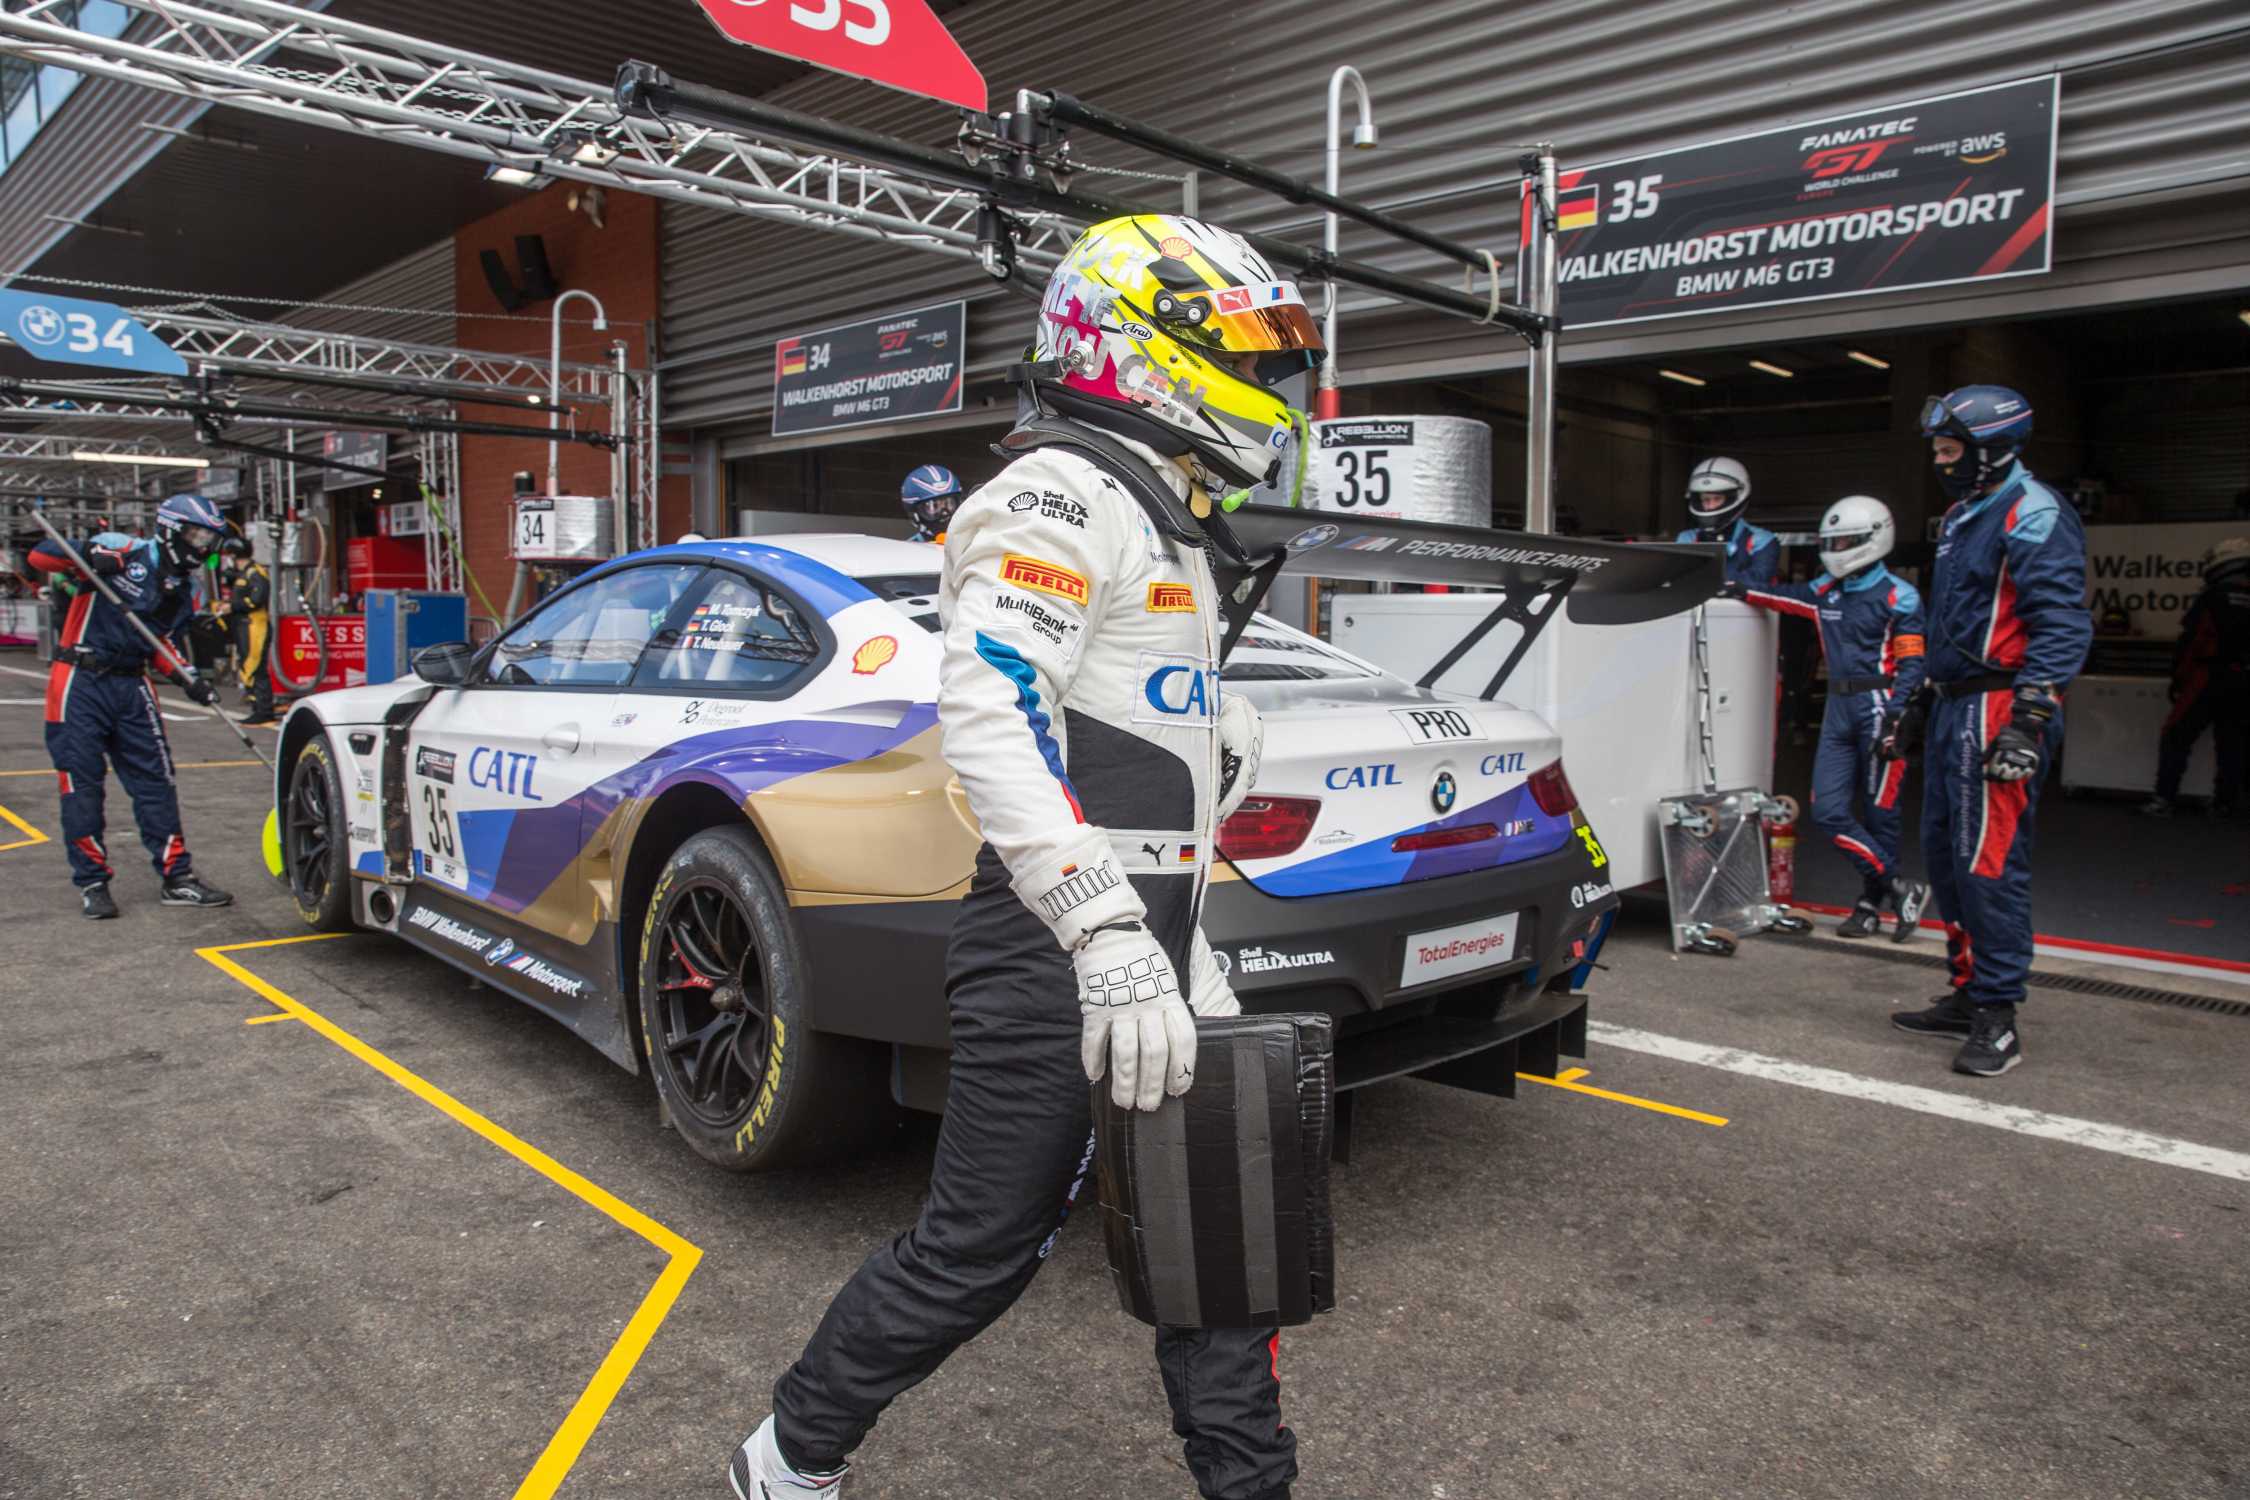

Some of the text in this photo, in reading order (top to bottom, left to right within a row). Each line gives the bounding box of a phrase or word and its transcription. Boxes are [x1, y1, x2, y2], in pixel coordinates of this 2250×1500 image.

[1799, 117, 1918, 151] FANATEC
[1913, 140, 1958, 155] POWERED
[1960, 132, 2007, 154] aws
[1804, 168, 1900, 192] WORLD CHALLENGE
[1607, 174, 1663, 223] 35
[1767, 188, 2025, 253] MOTORSPORT
[1675, 257, 1835, 297] BMW M6 GT3
[66, 312, 134, 357] 34
[1123, 324, 1151, 339] Arai
[808, 343, 831, 371] 34
[782, 363, 953, 407] WALKENHORST MOTORSPORT
[832, 396, 890, 417] BMW M6 GT3
[1335, 450, 1391, 508] 35
[1042, 499, 1089, 519] HELIX
[1043, 490, 1065, 502] Shell
[522, 514, 545, 545] 34
[1041, 507, 1085, 529] ULTRA
[1396, 539, 1556, 567] PERFORMANCE
[1547, 553, 1611, 574] PARTS
[1004, 559, 1085, 599] PIRELLI
[1032, 621, 1062, 645] Group
[1407, 710, 1472, 739] PRO
[468, 746, 543, 802] CATL
[1325, 763, 1403, 790] CATL
[1480, 751, 1527, 776] CATL
[424, 784, 455, 858] 35
[1038, 859, 1121, 922] PUMA
[408, 905, 493, 951] BMW Walkenhorst
[1239, 946, 1263, 959] Shell
[1240, 950, 1335, 974] HELIX ULTRA
[1417, 932, 1505, 965] TotalEnergies
[523, 960, 583, 998] Motorsport
[735, 1014, 785, 1152] PIRELLI
